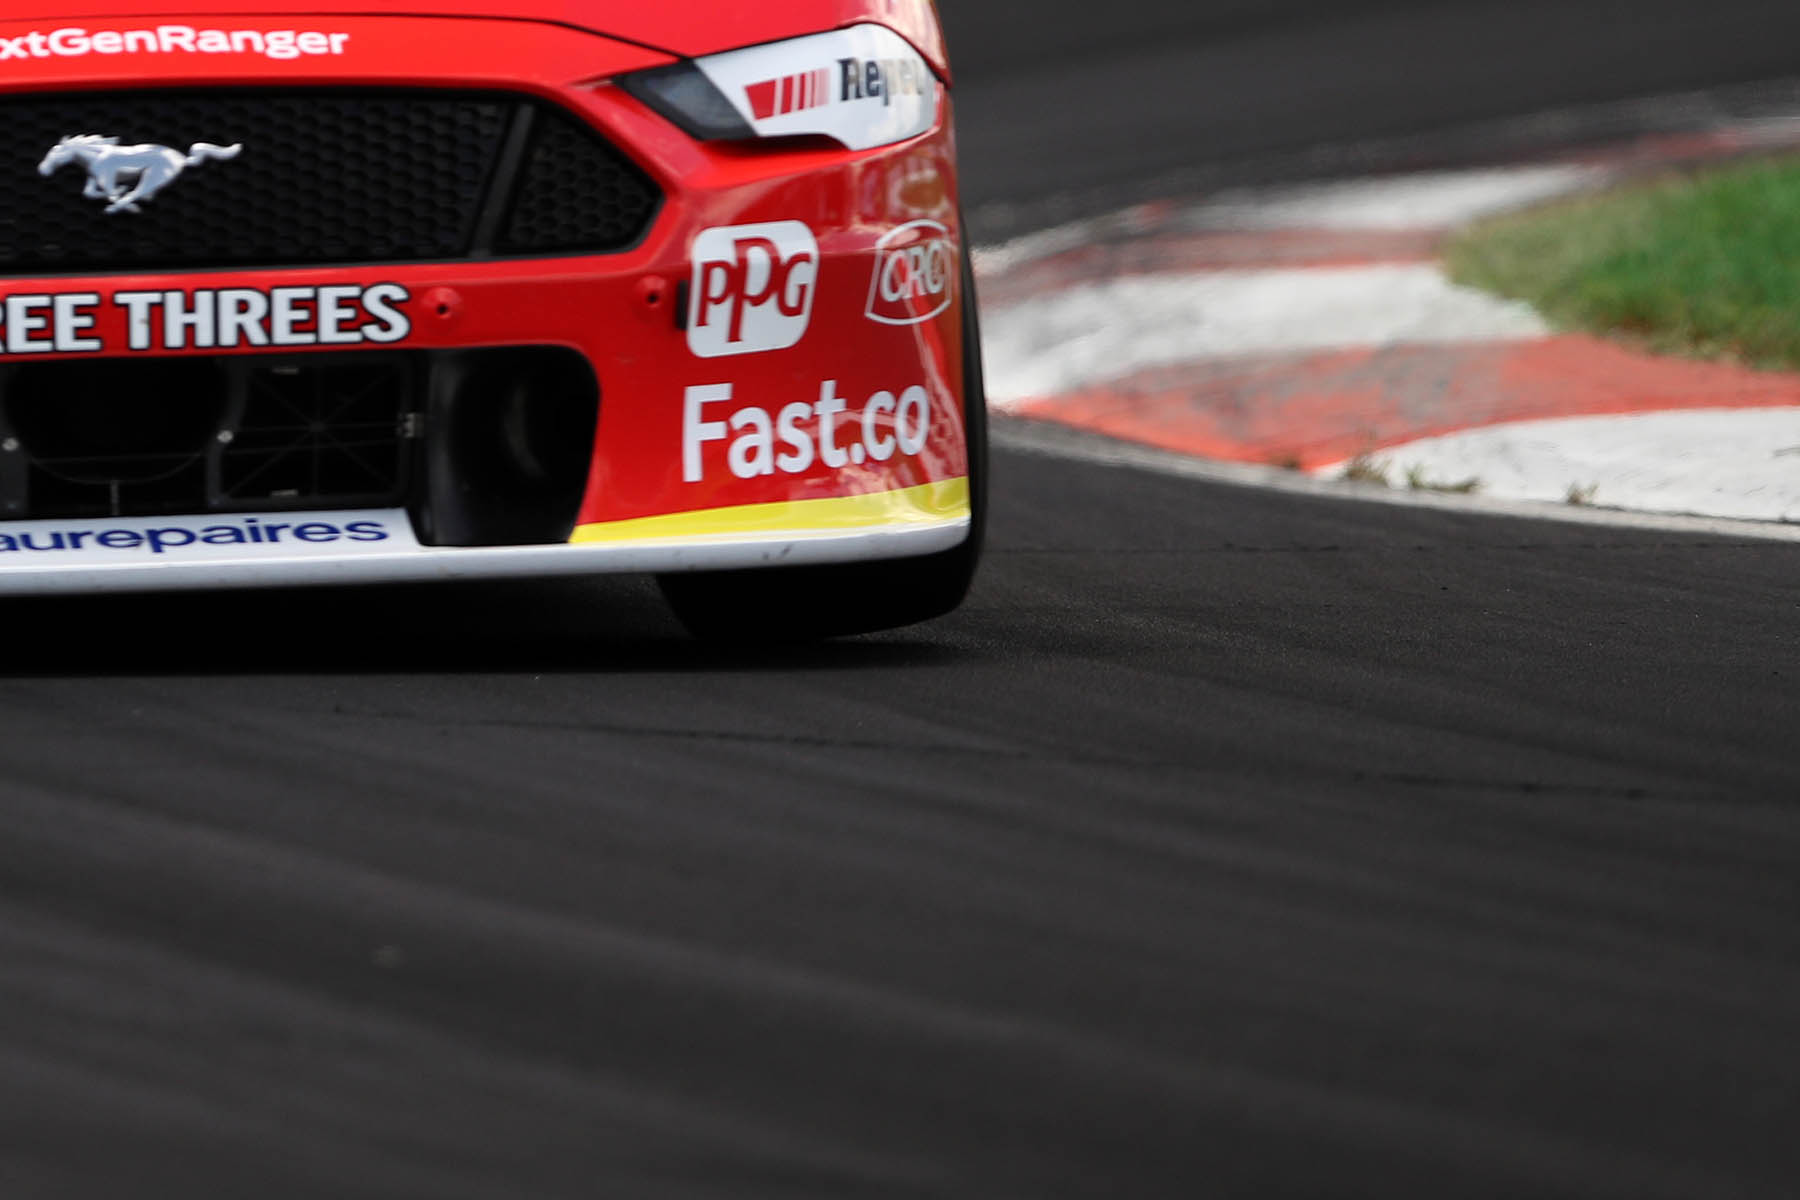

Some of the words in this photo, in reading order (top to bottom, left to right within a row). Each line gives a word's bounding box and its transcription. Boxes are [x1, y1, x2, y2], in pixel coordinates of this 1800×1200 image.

[114, 283, 412, 351] THREES
[696, 237, 816, 343] PPG
[880, 248, 946, 302] CRC
[682, 380, 930, 482] Fast.co
